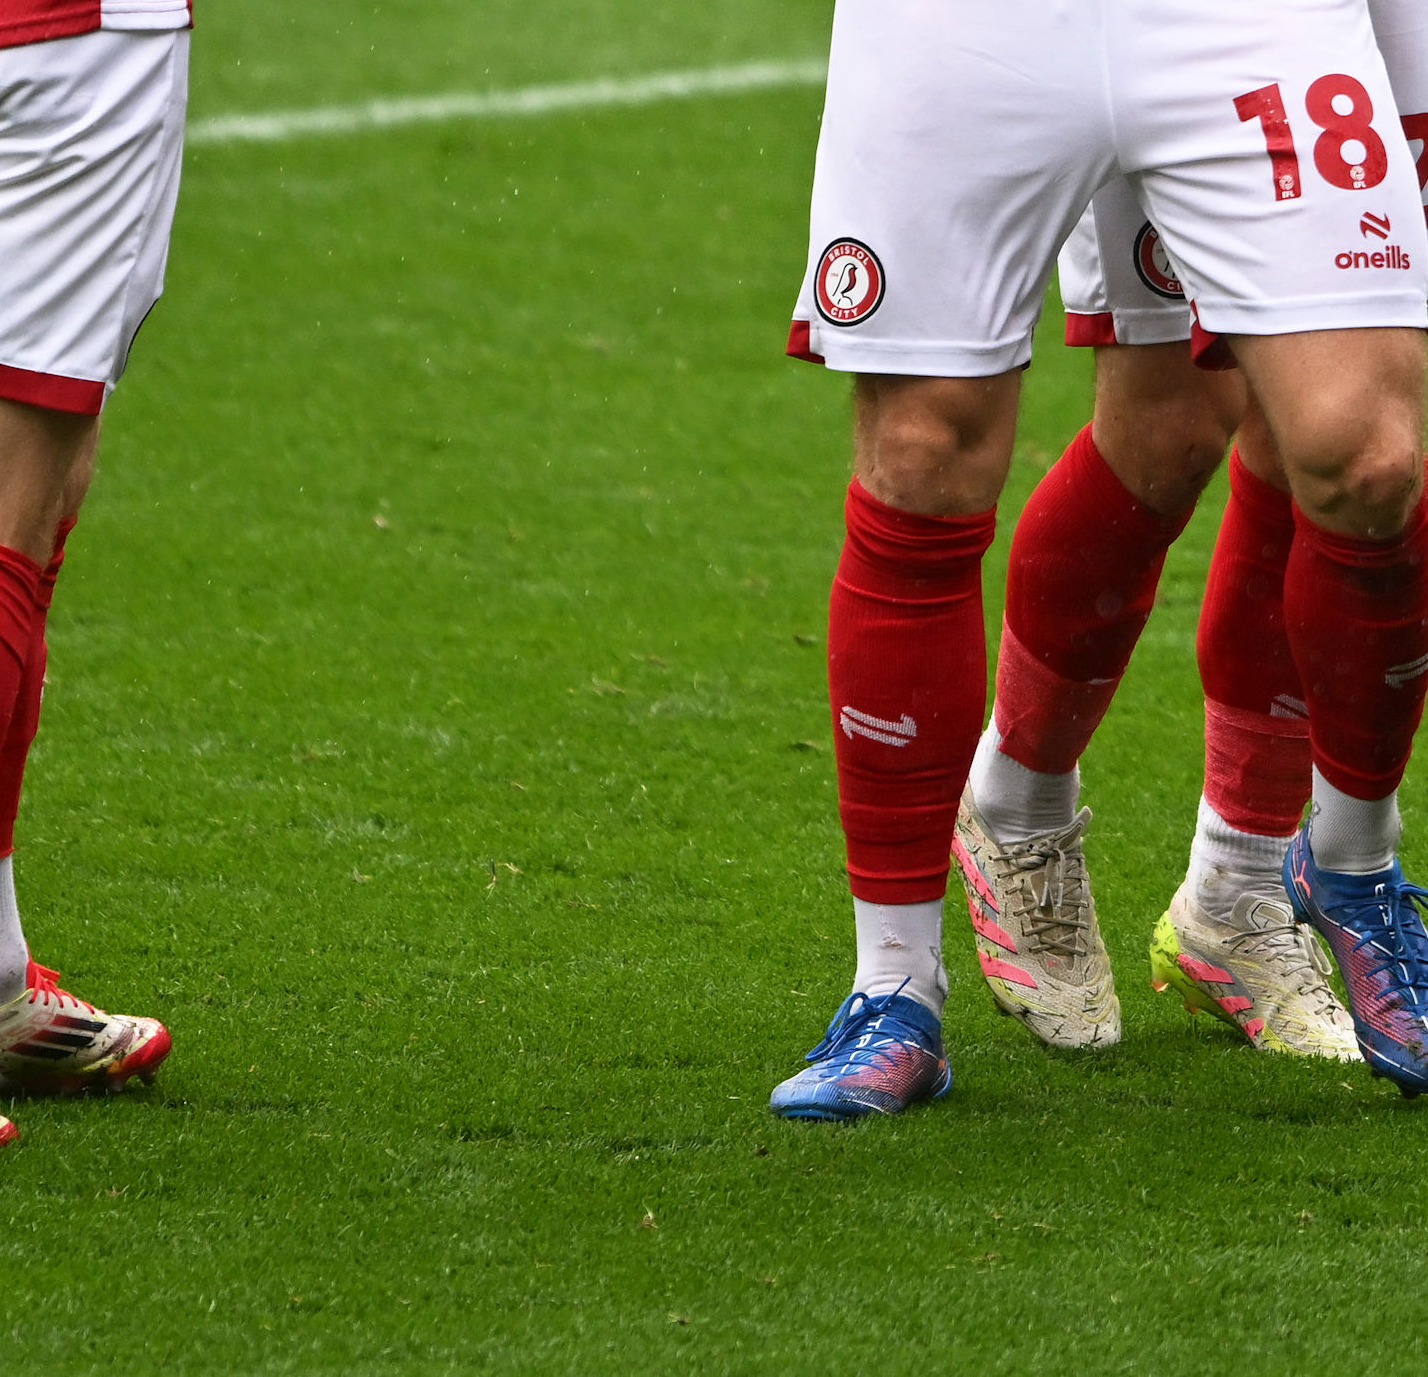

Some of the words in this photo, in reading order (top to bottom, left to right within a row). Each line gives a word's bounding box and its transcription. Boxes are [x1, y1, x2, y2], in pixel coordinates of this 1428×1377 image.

[1233, 73, 1388, 201] 18
[828, 245, 870, 265] BRISTOL
[1167, 282, 1180, 291] CI
[830, 307, 858, 318] CITY
